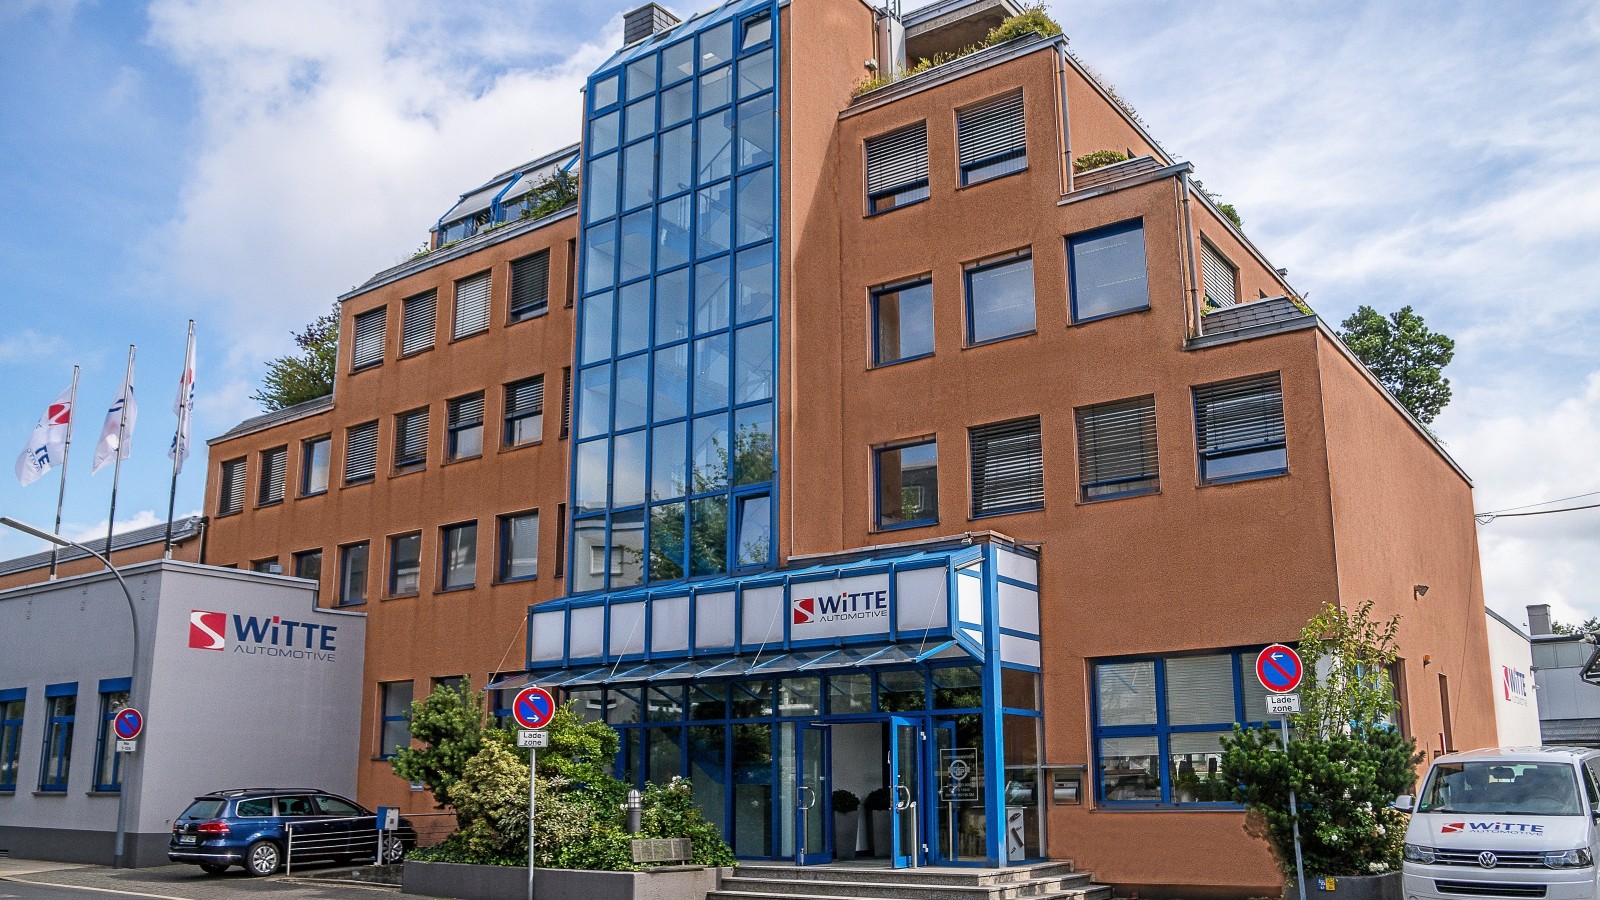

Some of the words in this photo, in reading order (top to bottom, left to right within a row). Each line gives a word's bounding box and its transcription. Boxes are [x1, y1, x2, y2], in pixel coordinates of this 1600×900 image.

[817, 590, 887, 614] WiTTE
[819, 609, 888, 623] AUTOMOTIVE
[233, 614, 337, 651] WiTTE
[233, 644, 336, 662] AUTOMOTIVE
[1271, 696, 1296, 704] Lade-
[1272, 704, 1293, 712] zone
[523, 731, 546, 739] Lade-
[1469, 828, 1544, 837] AUTOMOTIVE
